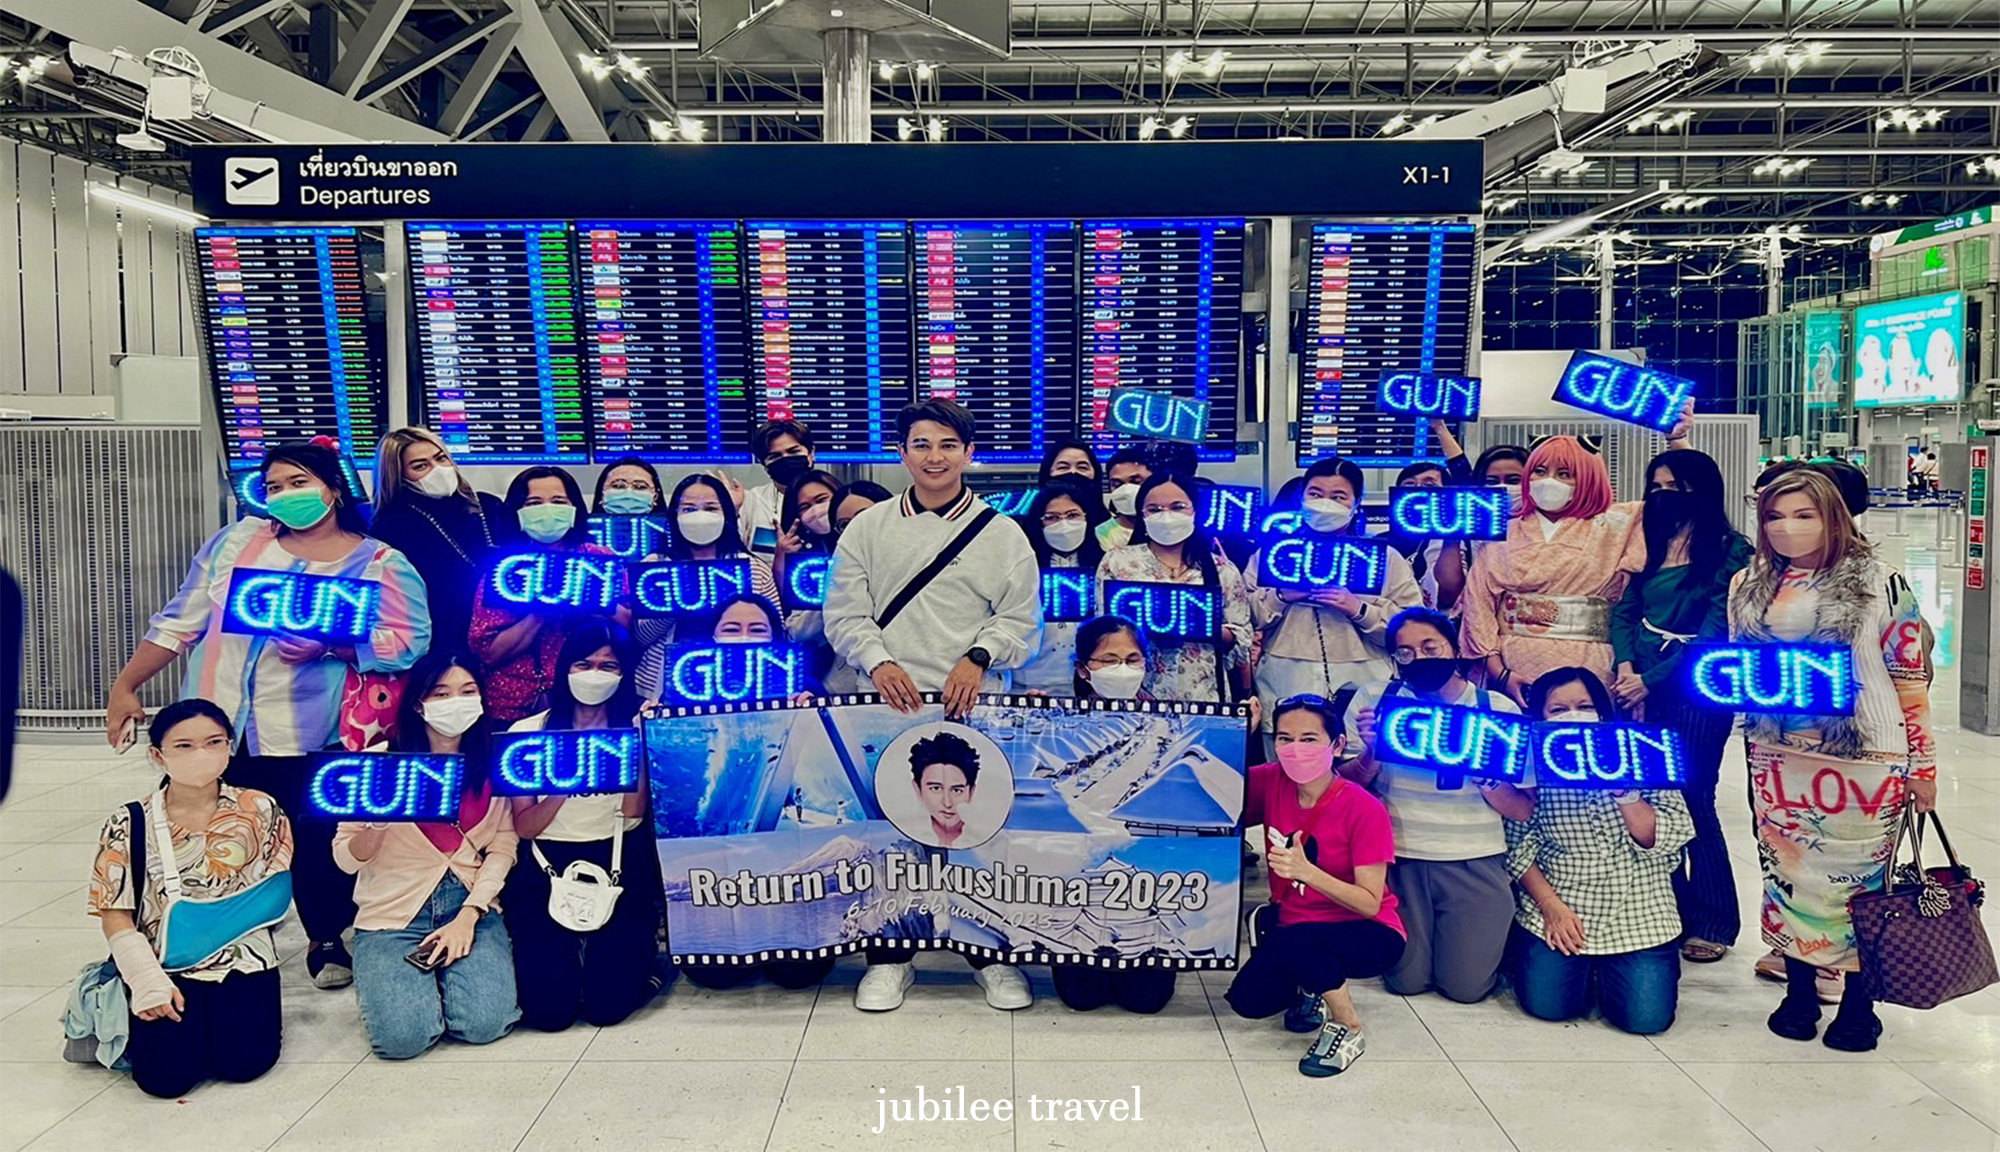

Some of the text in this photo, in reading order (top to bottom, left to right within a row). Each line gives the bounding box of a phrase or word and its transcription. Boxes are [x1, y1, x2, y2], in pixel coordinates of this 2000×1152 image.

[299, 148, 457, 177] เที่ยวบินขาออก
[1402, 166, 1450, 184] X1-1
[300, 185, 431, 210] Departures
[1112, 389, 1205, 439] GUN
[1382, 374, 1475, 418] GUN
[1568, 358, 1690, 425] GUN
[1394, 491, 1505, 536] GUN
[493, 554, 617, 608] GUN
[635, 565, 743, 611] GUN
[1267, 539, 1379, 588] GUN
[236, 575, 370, 636] GUN
[1110, 587, 1212, 636] GUN
[672, 647, 796, 702] GUN
[1692, 649, 1842, 708] GUN
[499, 733, 638, 790] GUN
[1387, 706, 1521, 776] GUN
[1543, 727, 1674, 782] GUN
[309, 757, 463, 817] GUN
[688, 852, 1208, 911] Return to Fukushima 2023
[847, 895, 1055, 930] 6-10 February 2023
